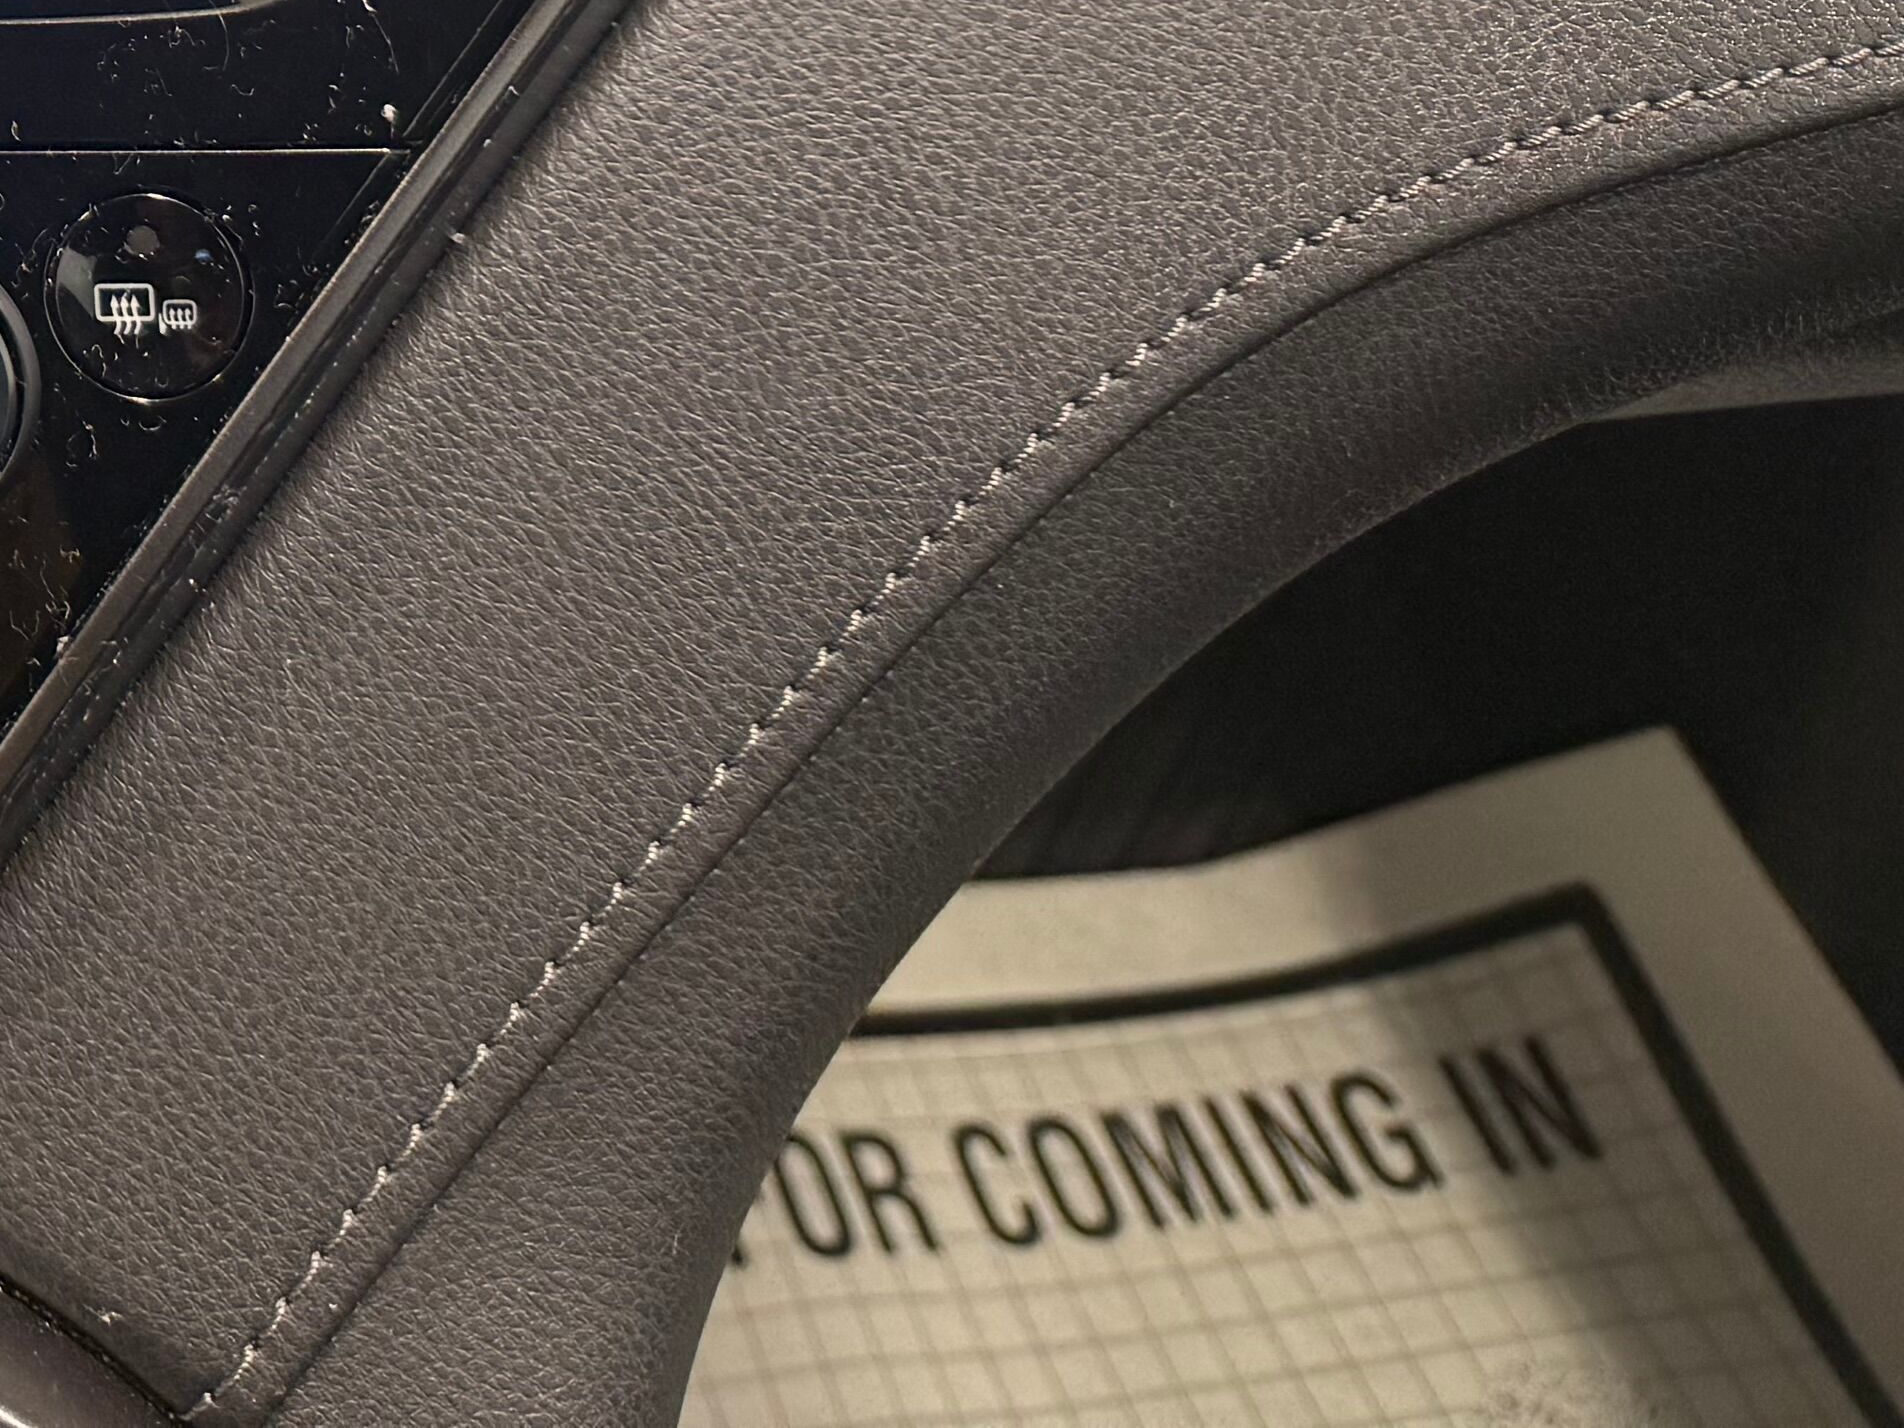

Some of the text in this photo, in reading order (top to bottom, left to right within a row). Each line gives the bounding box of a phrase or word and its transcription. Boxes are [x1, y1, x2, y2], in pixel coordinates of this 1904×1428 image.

[732, 1034, 1608, 1260] OR COMING IN
